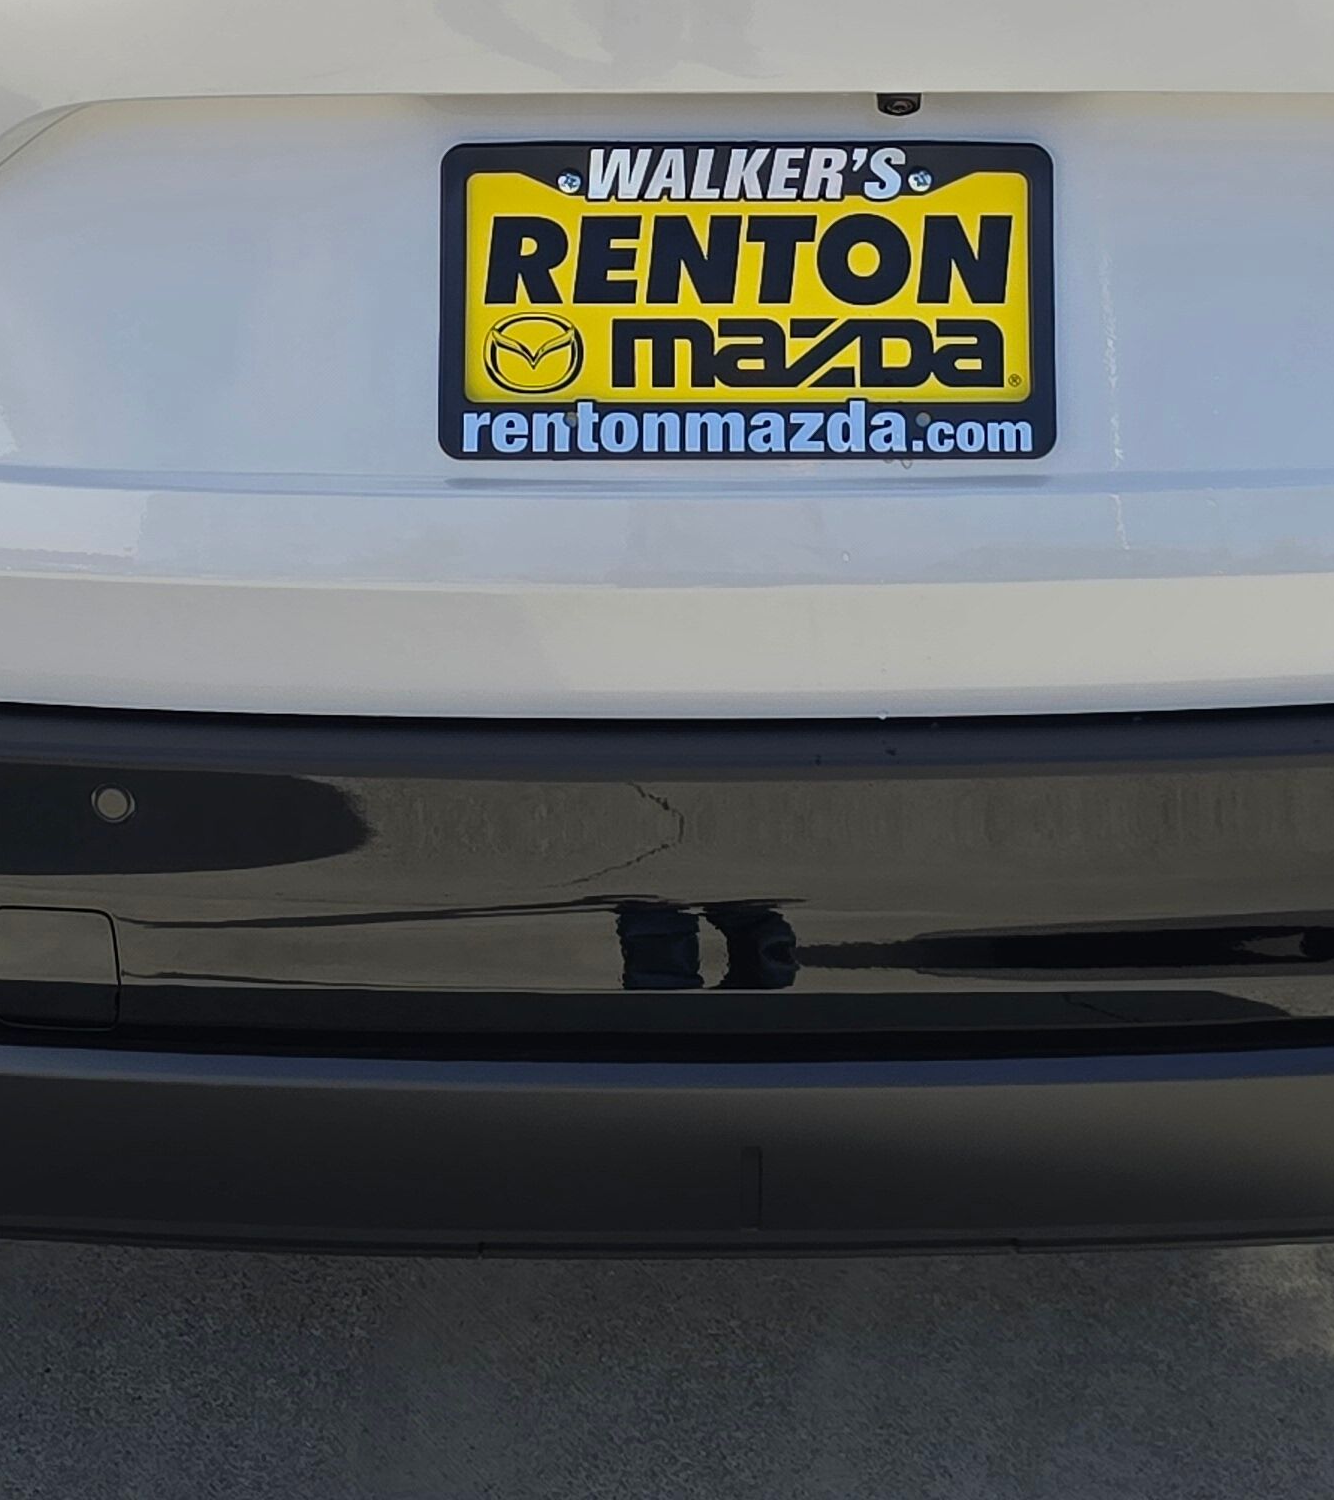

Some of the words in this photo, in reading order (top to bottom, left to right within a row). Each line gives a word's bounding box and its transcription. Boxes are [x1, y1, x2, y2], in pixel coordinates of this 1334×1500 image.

[585, 147, 908, 201] WALKER'S
[484, 213, 1014, 305] RENTON
[462, 402, 1034, 454] rentonmazda.com
